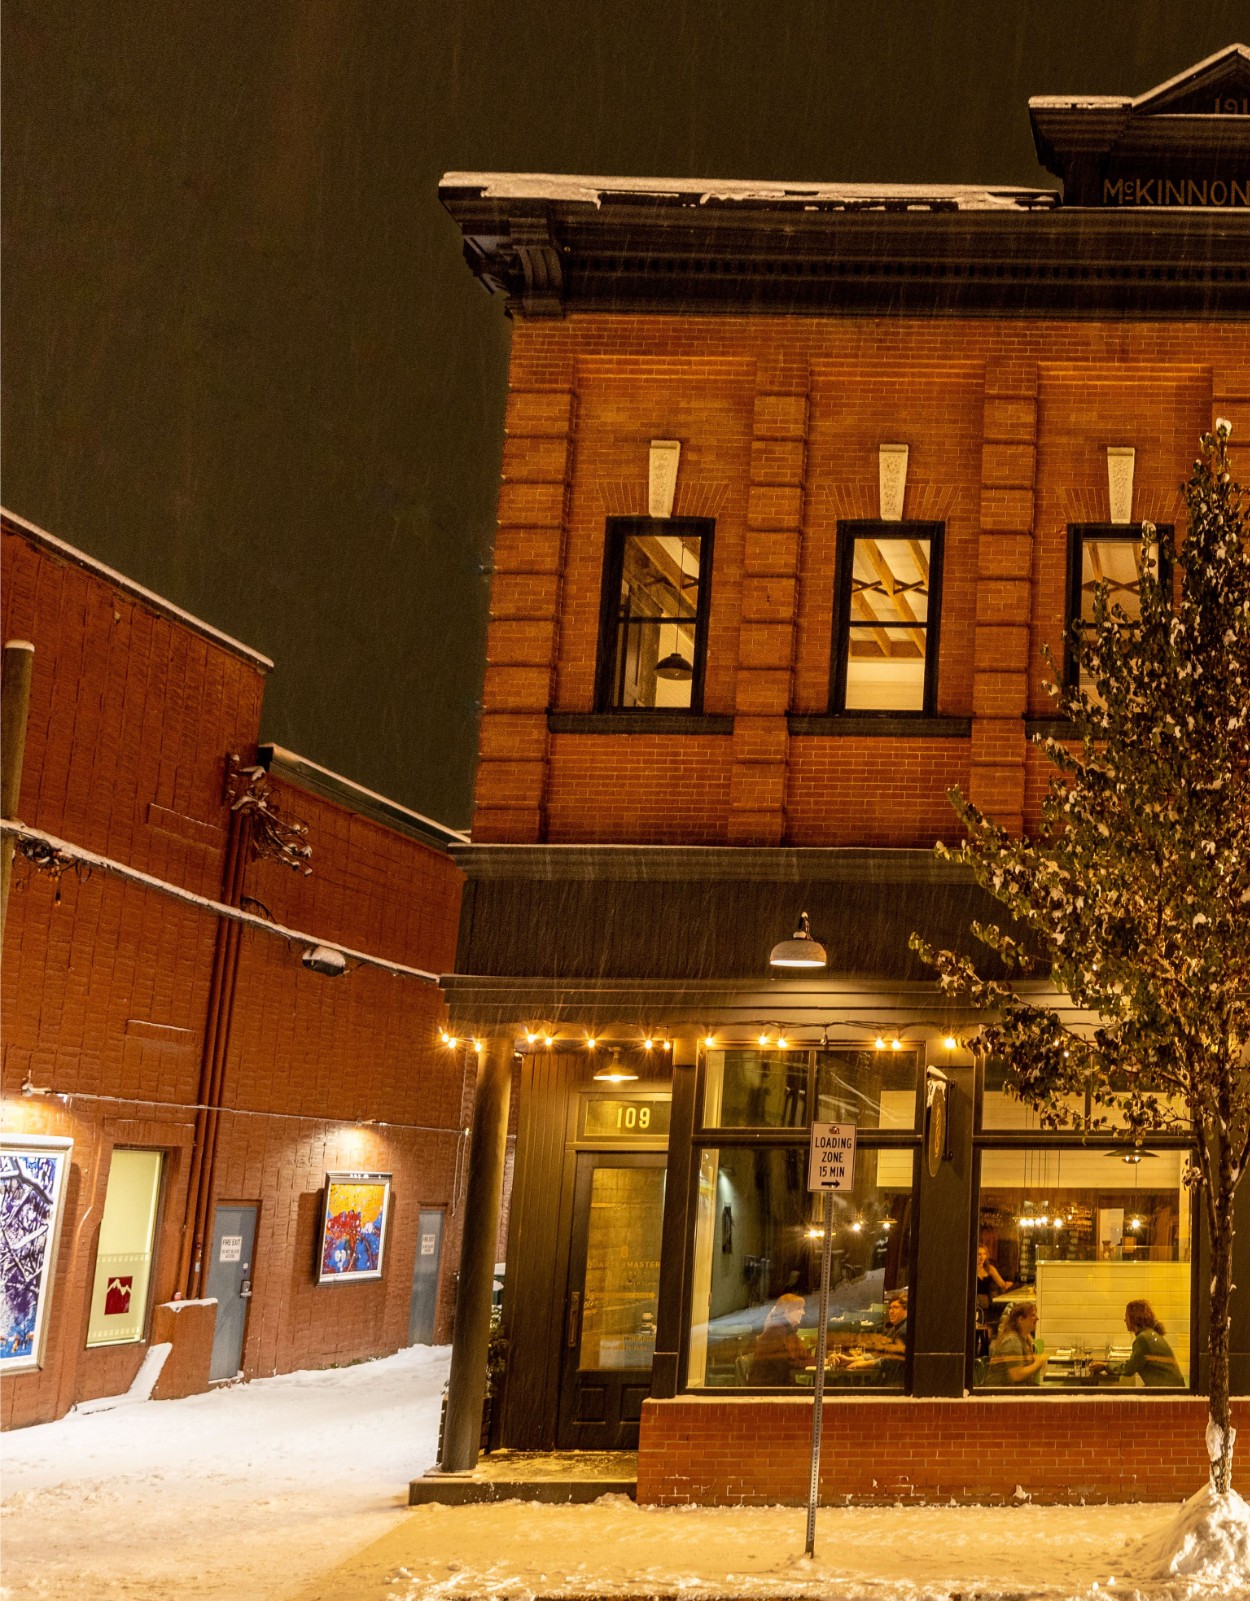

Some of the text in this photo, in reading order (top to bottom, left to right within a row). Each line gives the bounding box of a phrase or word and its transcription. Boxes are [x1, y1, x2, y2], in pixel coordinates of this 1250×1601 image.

[616, 1107, 651, 1129] 109
[815, 1136, 852, 1149] LOADING
[821, 1151, 844, 1163] ZONE
[818, 1165, 845, 1178] 15 MIN
